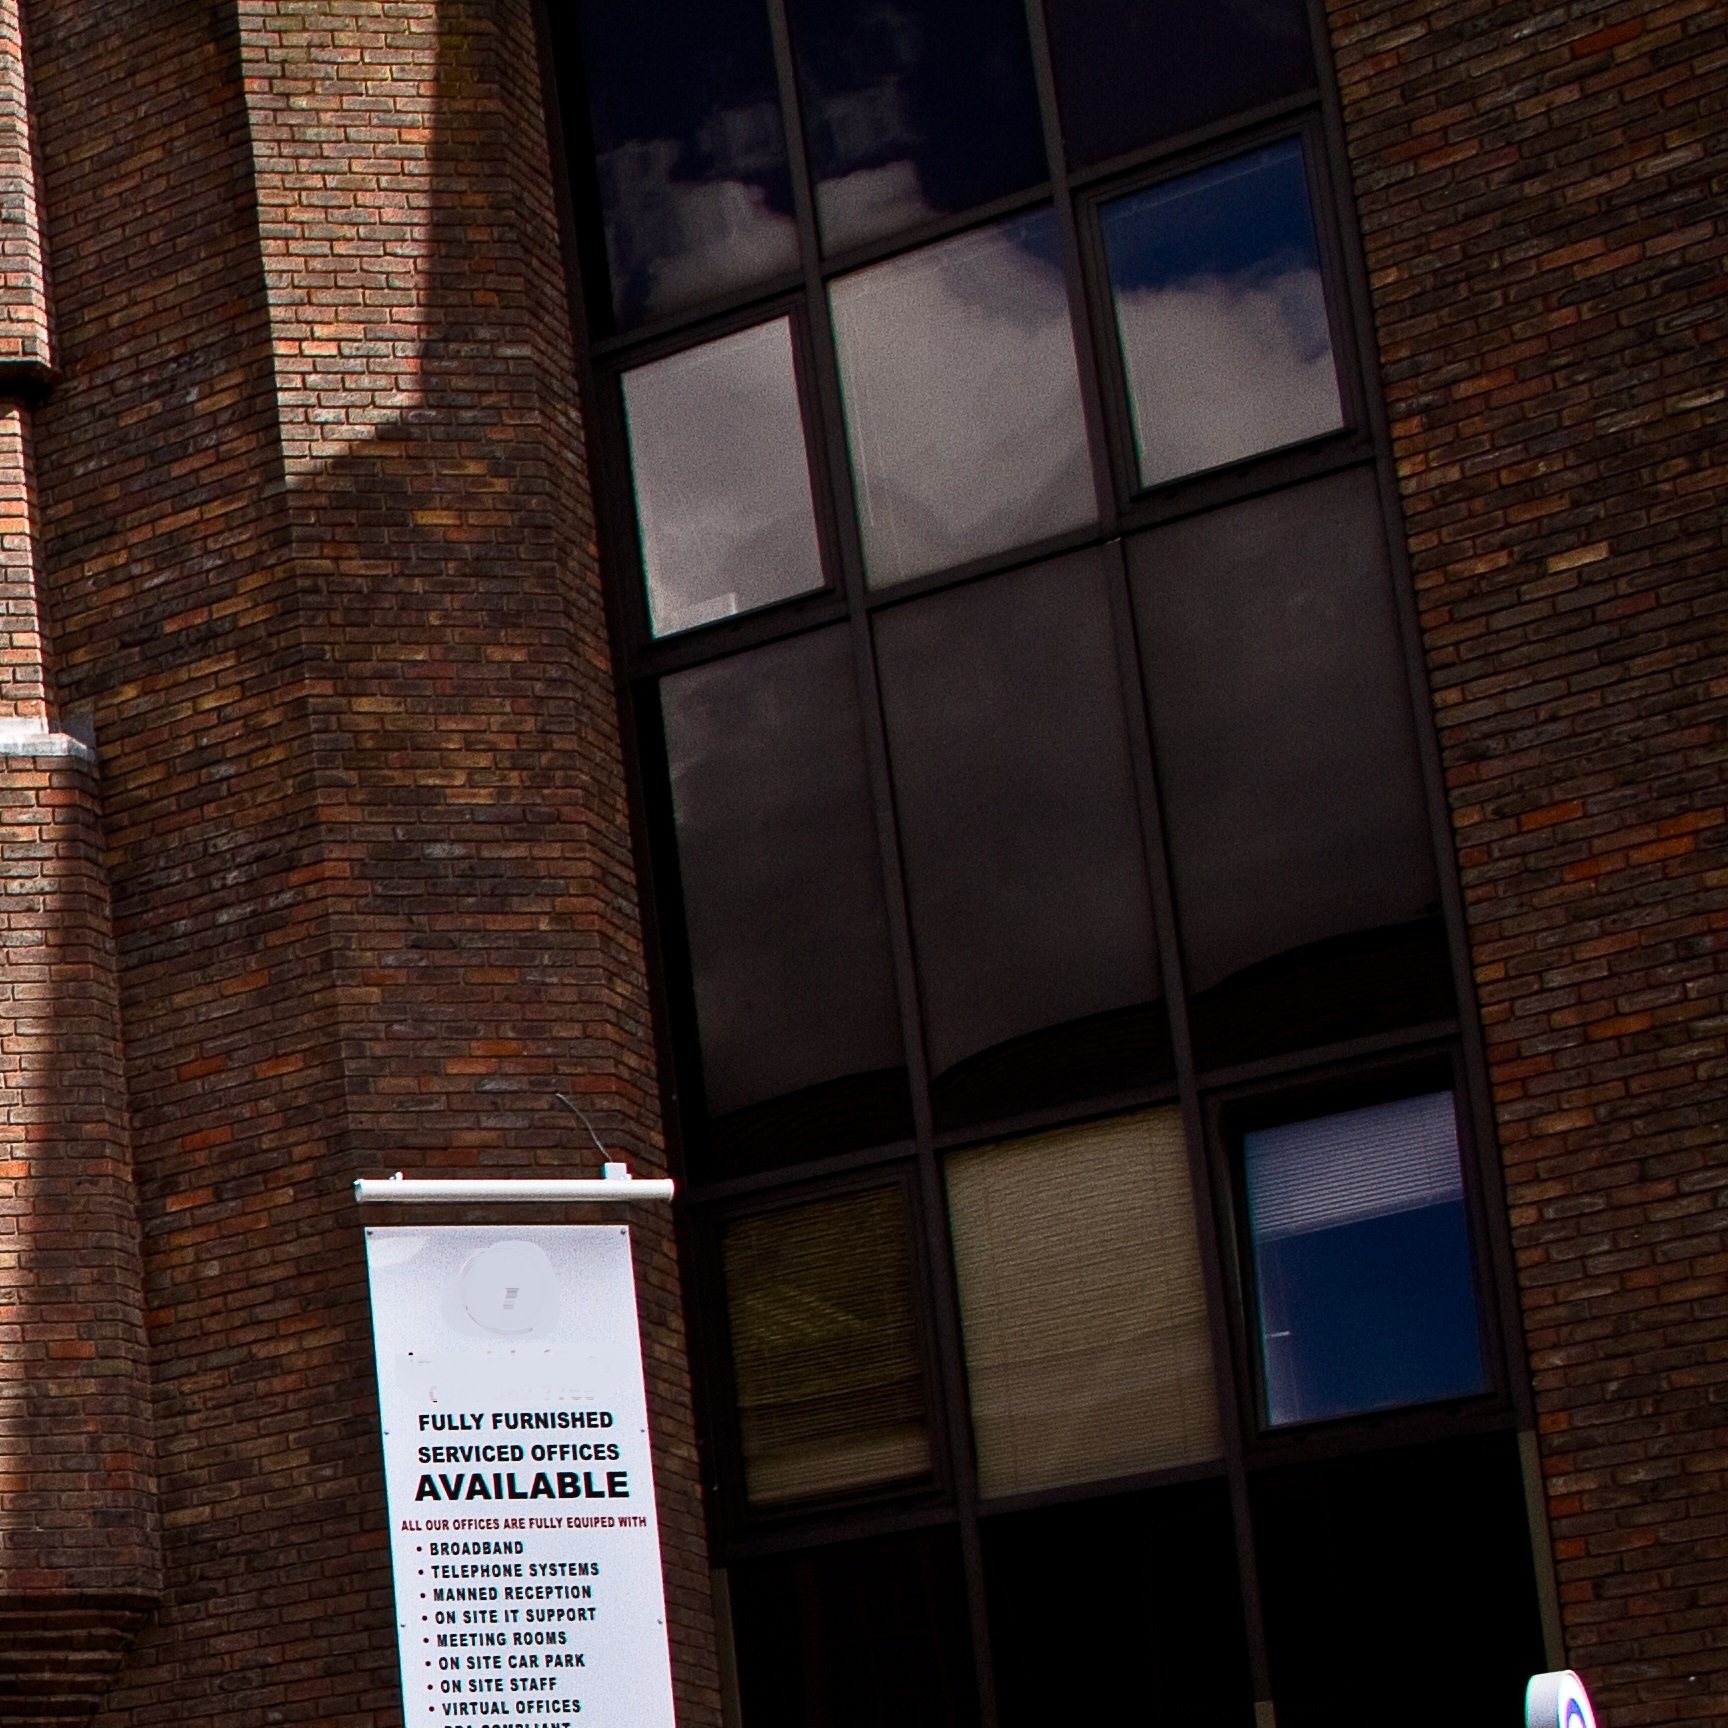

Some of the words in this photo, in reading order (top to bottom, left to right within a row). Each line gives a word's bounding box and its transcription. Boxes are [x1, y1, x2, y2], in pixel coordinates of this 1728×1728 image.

[418, 1413, 484, 1431] FULLY
[492, 1411, 614, 1430] FURNISHED
[418, 1445, 524, 1464] SERVICED
[531, 1443, 620, 1462] OFFICES
[414, 1471, 630, 1501] AVAILABLE
[401, 1519, 422, 1531] ALL
[425, 1519, 450, 1531] OUR
[452, 1518, 500, 1530] OFFICES
[503, 1517, 526, 1529] ARE
[528, 1517, 563, 1529] FULLY
[566, 1517, 615, 1528] EQUIPED
[617, 1516, 647, 1528] WITH
[430, 1541, 524, 1556] BROADBAND
[431, 1563, 523, 1578] TELEPHONE
[529, 1562, 600, 1577] SYSTEMS
[433, 1586, 498, 1601] MANNED
[505, 1585, 592, 1600] RECEPTION
[435, 1610, 456, 1624] ON
[463, 1609, 498, 1624] SITE
[505, 1609, 519, 1623] IT
[526, 1607, 596, 1622] SUPPORT
[437, 1632, 506, 1647] MEETING
[513, 1631, 567, 1646] ROOMS
[439, 1656, 460, 1670] ON
[467, 1655, 502, 1669] SITE
[508, 1655, 539, 1668] CAR
[545, 1653, 585, 1668] PARK
[441, 1680, 462, 1693] ON
[468, 1678, 504, 1693] SITE
[510, 1677, 557, 1692] STAFF
[442, 1701, 510, 1715] VIRTUAL
[516, 1699, 581, 1714] OFFICES
